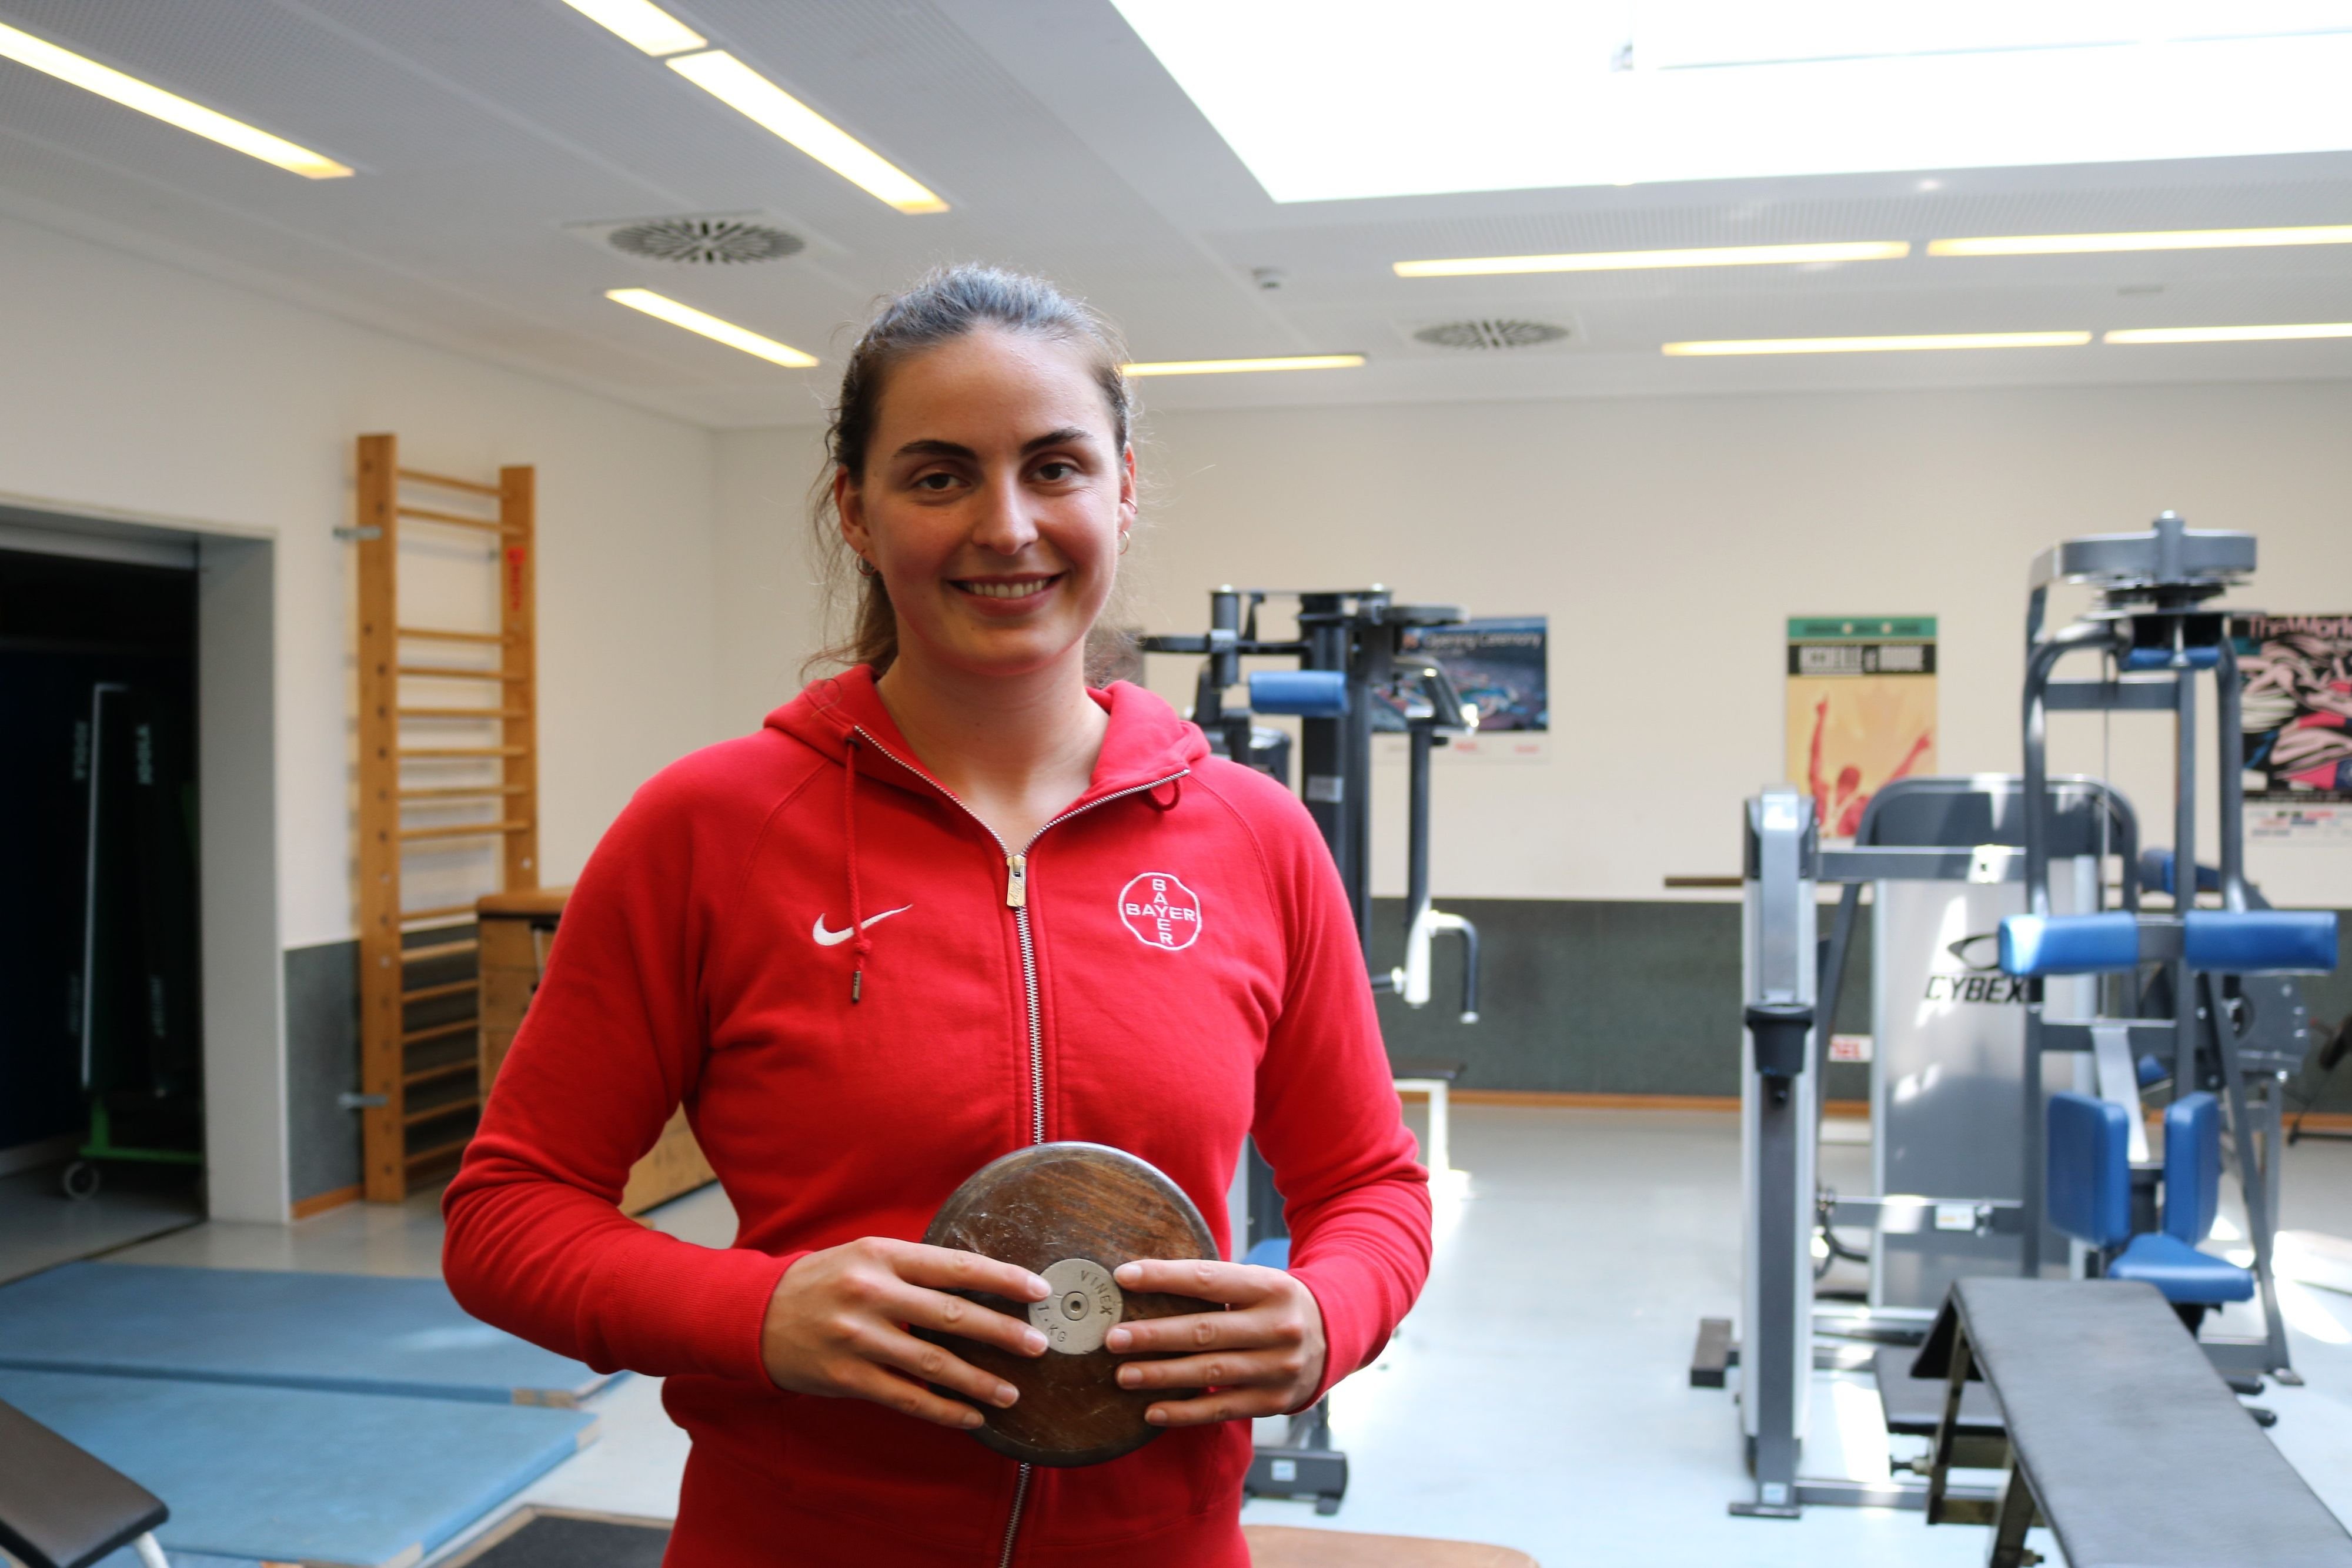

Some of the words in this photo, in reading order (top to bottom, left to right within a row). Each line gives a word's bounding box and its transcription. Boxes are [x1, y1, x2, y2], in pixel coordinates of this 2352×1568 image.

[1125, 903, 1196, 922] BAYER
[1152, 878, 1174, 945] BAYER
[1925, 975, 2024, 1003] CYBEX
[1081, 1270, 1113, 1315] VINEX
